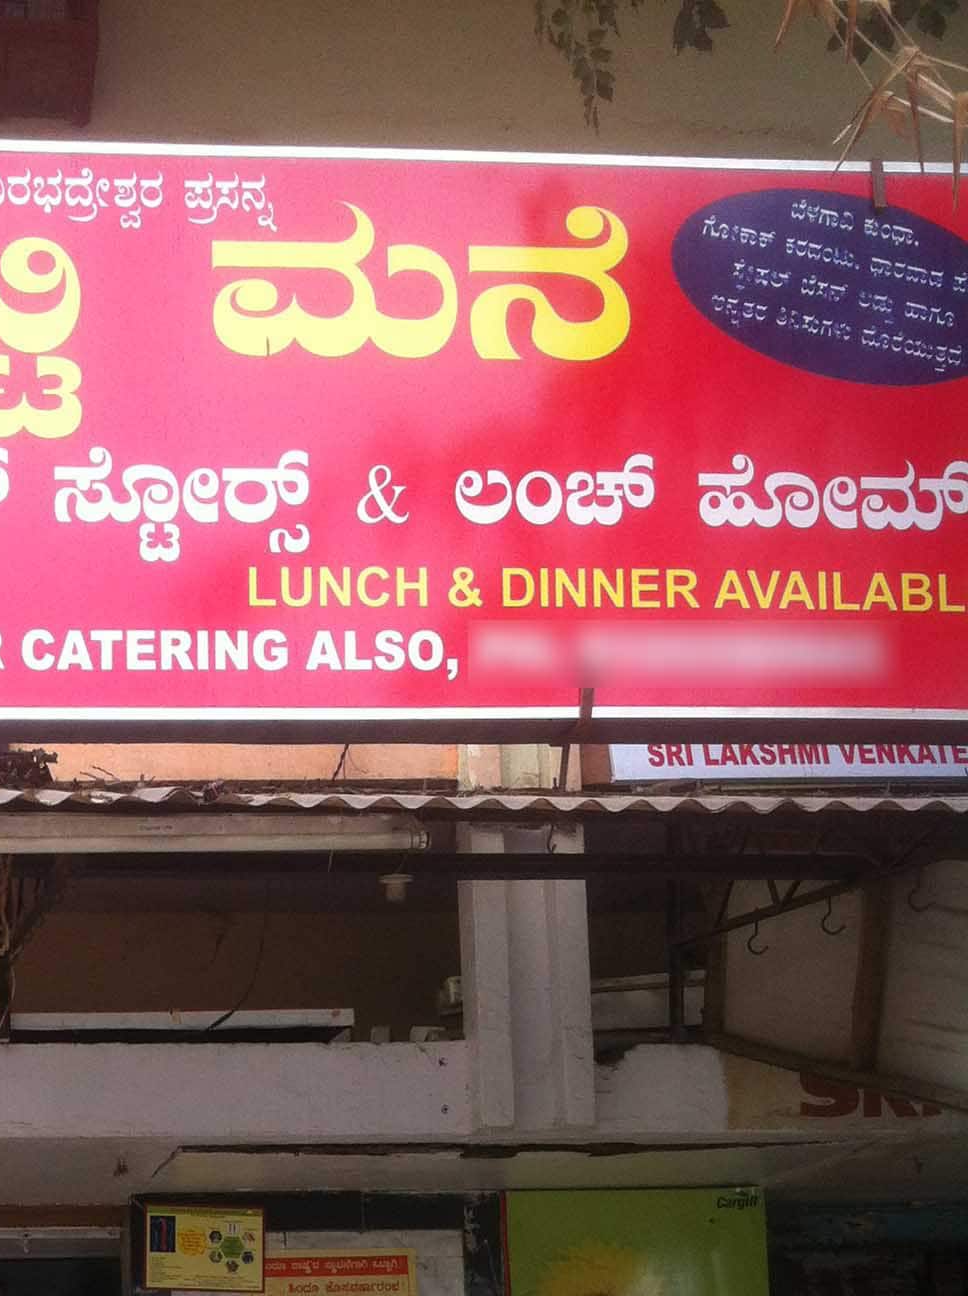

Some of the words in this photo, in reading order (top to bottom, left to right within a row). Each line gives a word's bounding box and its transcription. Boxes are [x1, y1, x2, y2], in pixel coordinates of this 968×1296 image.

[183, 173, 278, 232] ಪ್ರಸನ್ನ
[211, 201, 632, 362] ಮನೆ
[53, 446, 311, 563] ಸ್ಟೋರ್ಸ್
[355, 464, 410, 526] &
[454, 453, 656, 527] ಲಂಚ್
[248, 565, 429, 609] LUNCH
[447, 566, 483, 609] &
[501, 566, 701, 610] DINNER
[21, 629, 290, 672] CATERING
[305, 630, 459, 681] ALSO,
[648, 743, 695, 768] SRI
[703, 743, 830, 766] LAKSHMI
